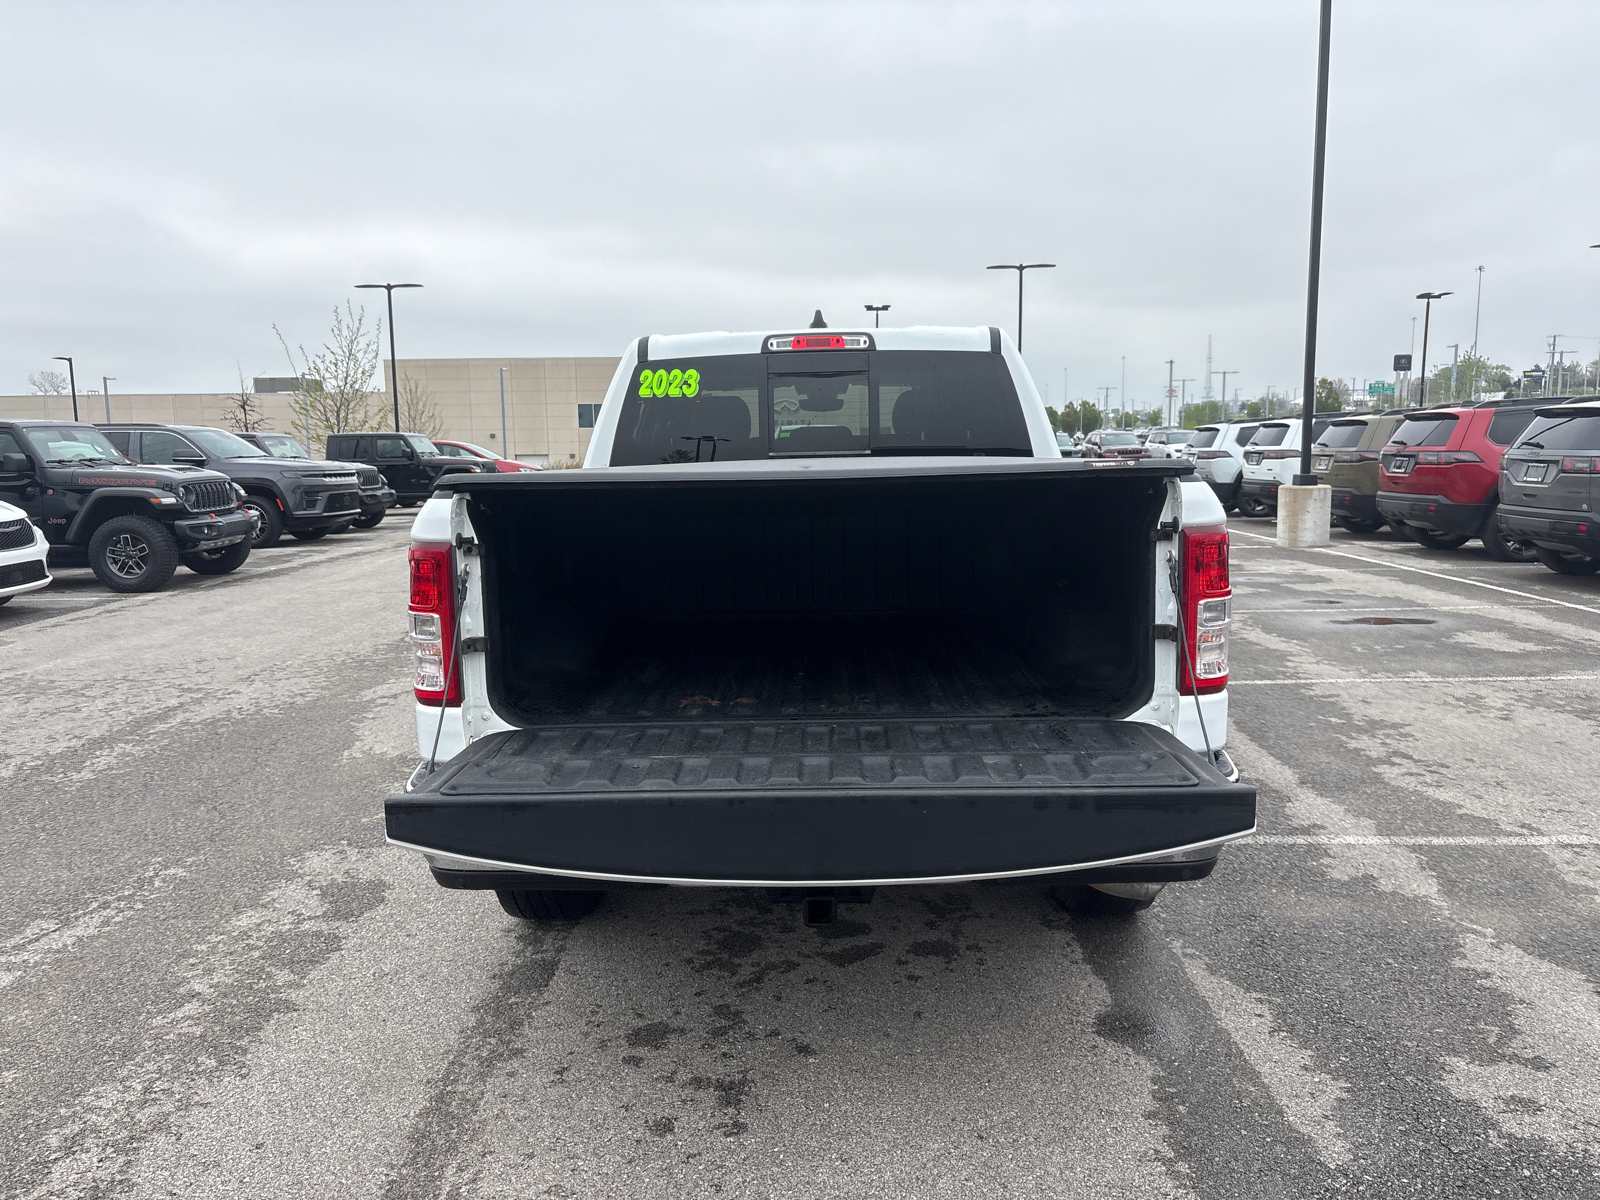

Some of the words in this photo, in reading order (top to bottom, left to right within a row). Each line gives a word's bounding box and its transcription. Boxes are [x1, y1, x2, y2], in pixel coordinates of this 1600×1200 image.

[639, 369, 700, 398] 2023
[78, 477, 157, 486] MOJAVE
[47, 517, 66, 525] Jeep
